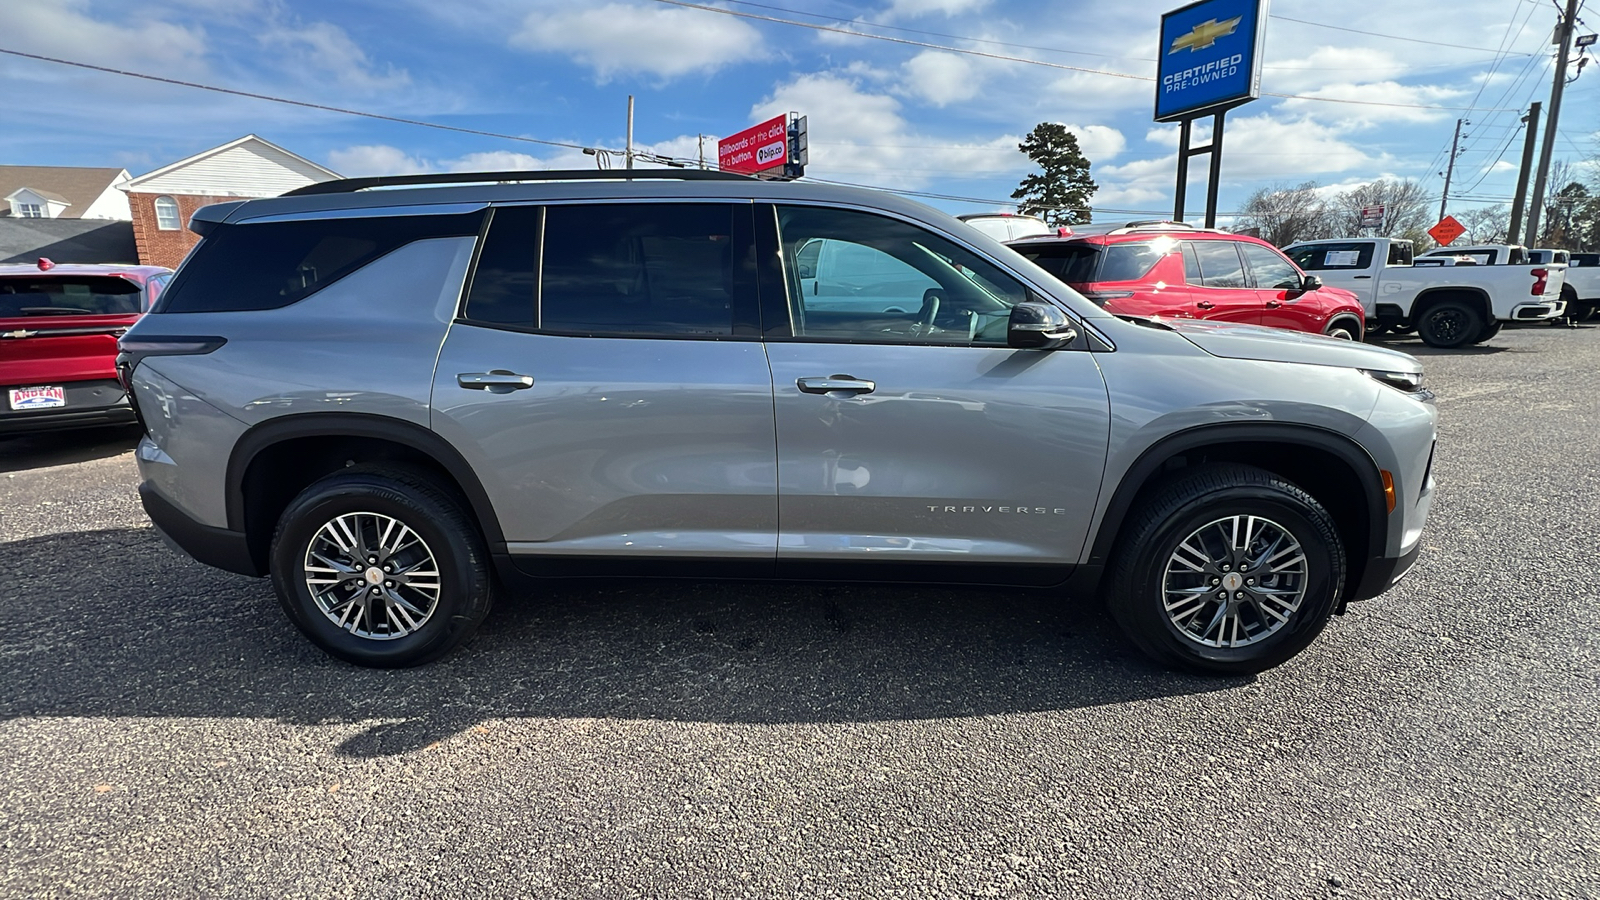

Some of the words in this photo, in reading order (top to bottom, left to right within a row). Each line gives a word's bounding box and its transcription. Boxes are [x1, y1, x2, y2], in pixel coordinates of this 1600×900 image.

[1163, 54, 1242, 85] CERTIFIED
[1166, 66, 1237, 93] PRE-OWNED
[720, 137, 748, 156] Billboards
[749, 134, 757, 146] at
[757, 130, 768, 143] the
[768, 123, 784, 138] click
[726, 157, 731, 166] a
[731, 151, 753, 165] button.
[763, 146, 783, 159] blip.co
[14, 388, 64, 403] ANDEAN
[926, 505, 1066, 515] TRAVERSE
